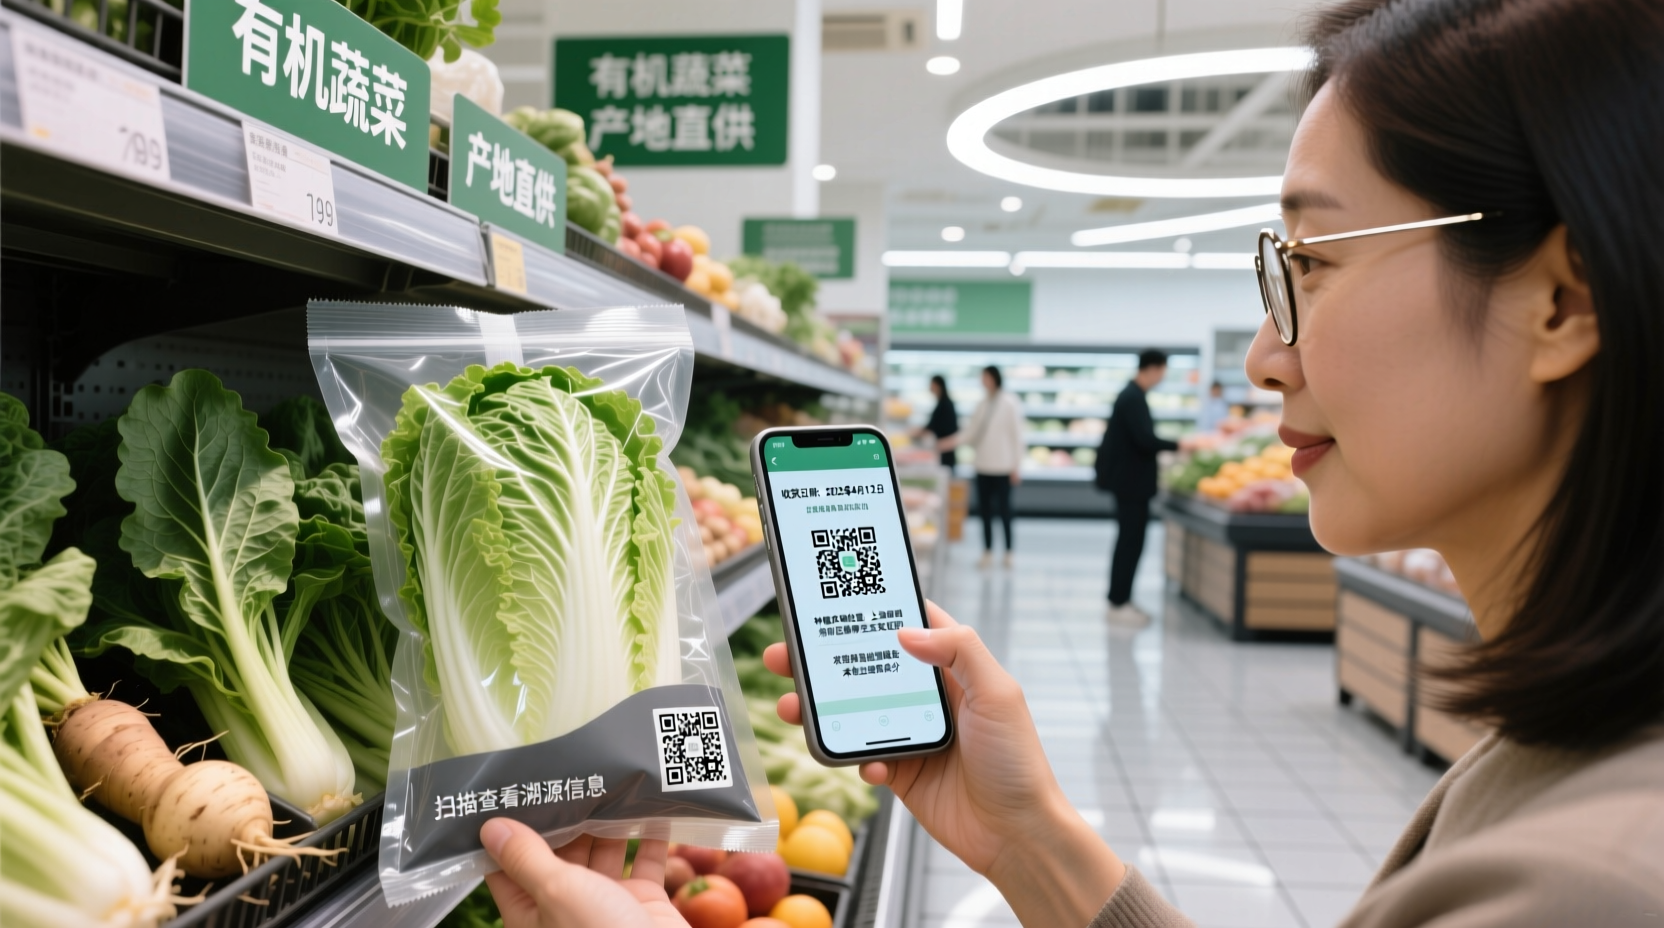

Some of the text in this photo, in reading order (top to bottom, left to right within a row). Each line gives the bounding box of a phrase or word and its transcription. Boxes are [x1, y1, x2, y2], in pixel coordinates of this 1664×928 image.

[232, 0, 407, 150] 有机蔬菜
[589, 51, 753, 99] 有机蔬菜
[588, 102, 756, 151] 产地直供
[465, 131, 556, 229] 产地直供
[434, 773, 607, 821] 扫描查看溯源信息
